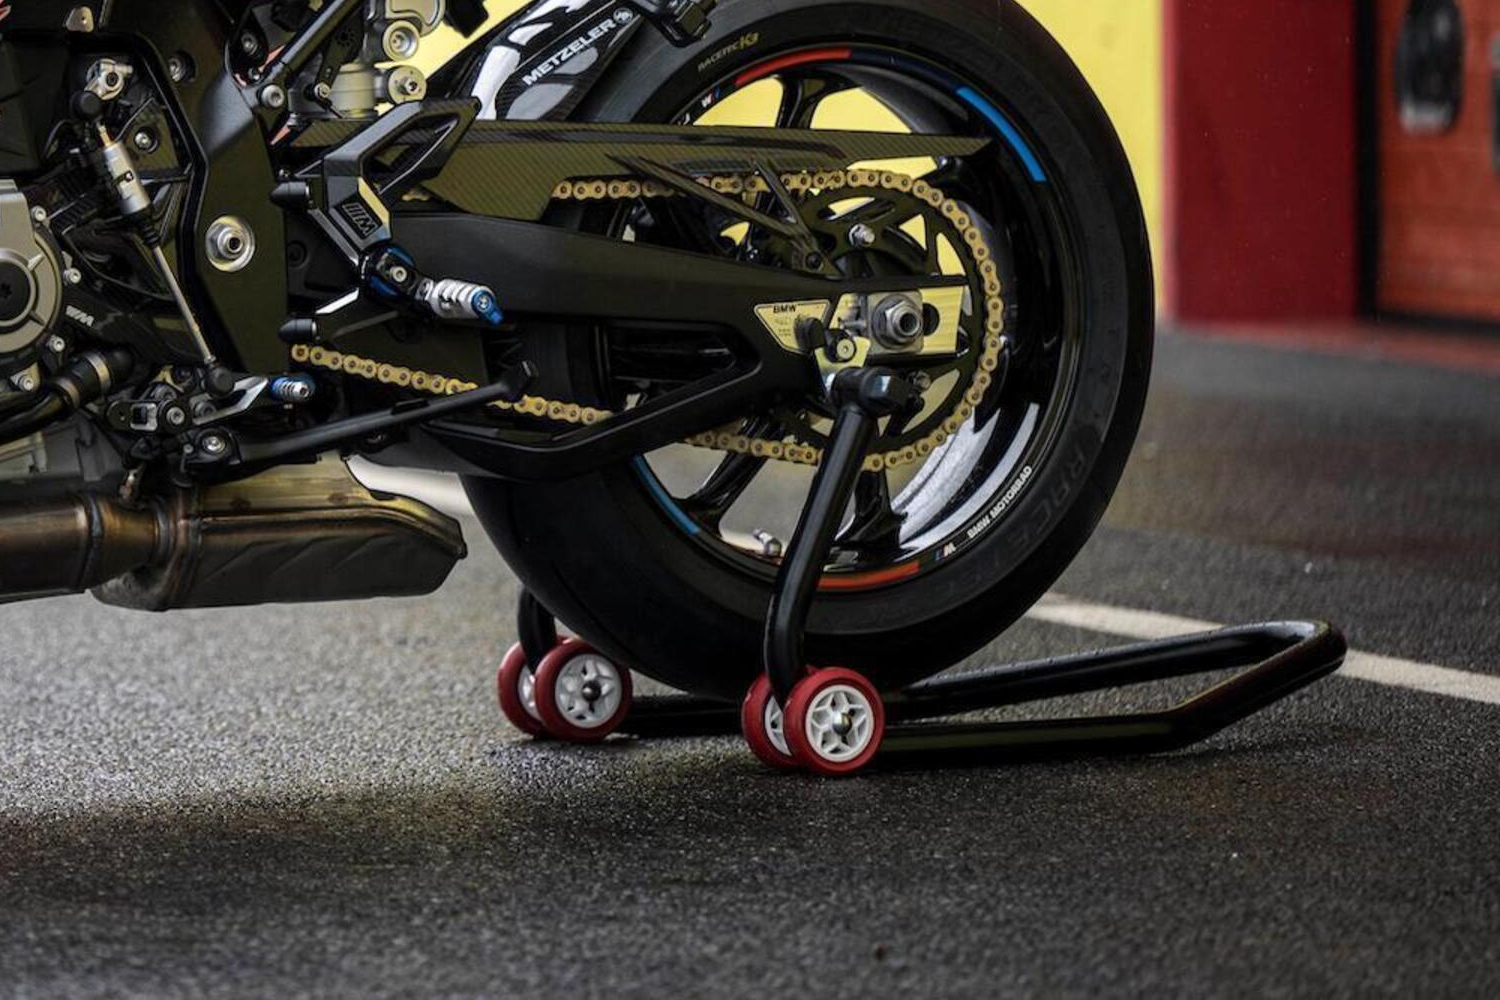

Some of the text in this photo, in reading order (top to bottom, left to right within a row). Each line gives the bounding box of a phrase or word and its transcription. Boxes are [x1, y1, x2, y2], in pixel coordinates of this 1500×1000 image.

[522, 18, 617, 86] METZELER
[772, 303, 797, 314] BMW
[967, 514, 991, 539] BMW
[989, 465, 1032, 519] MOTORRAD
